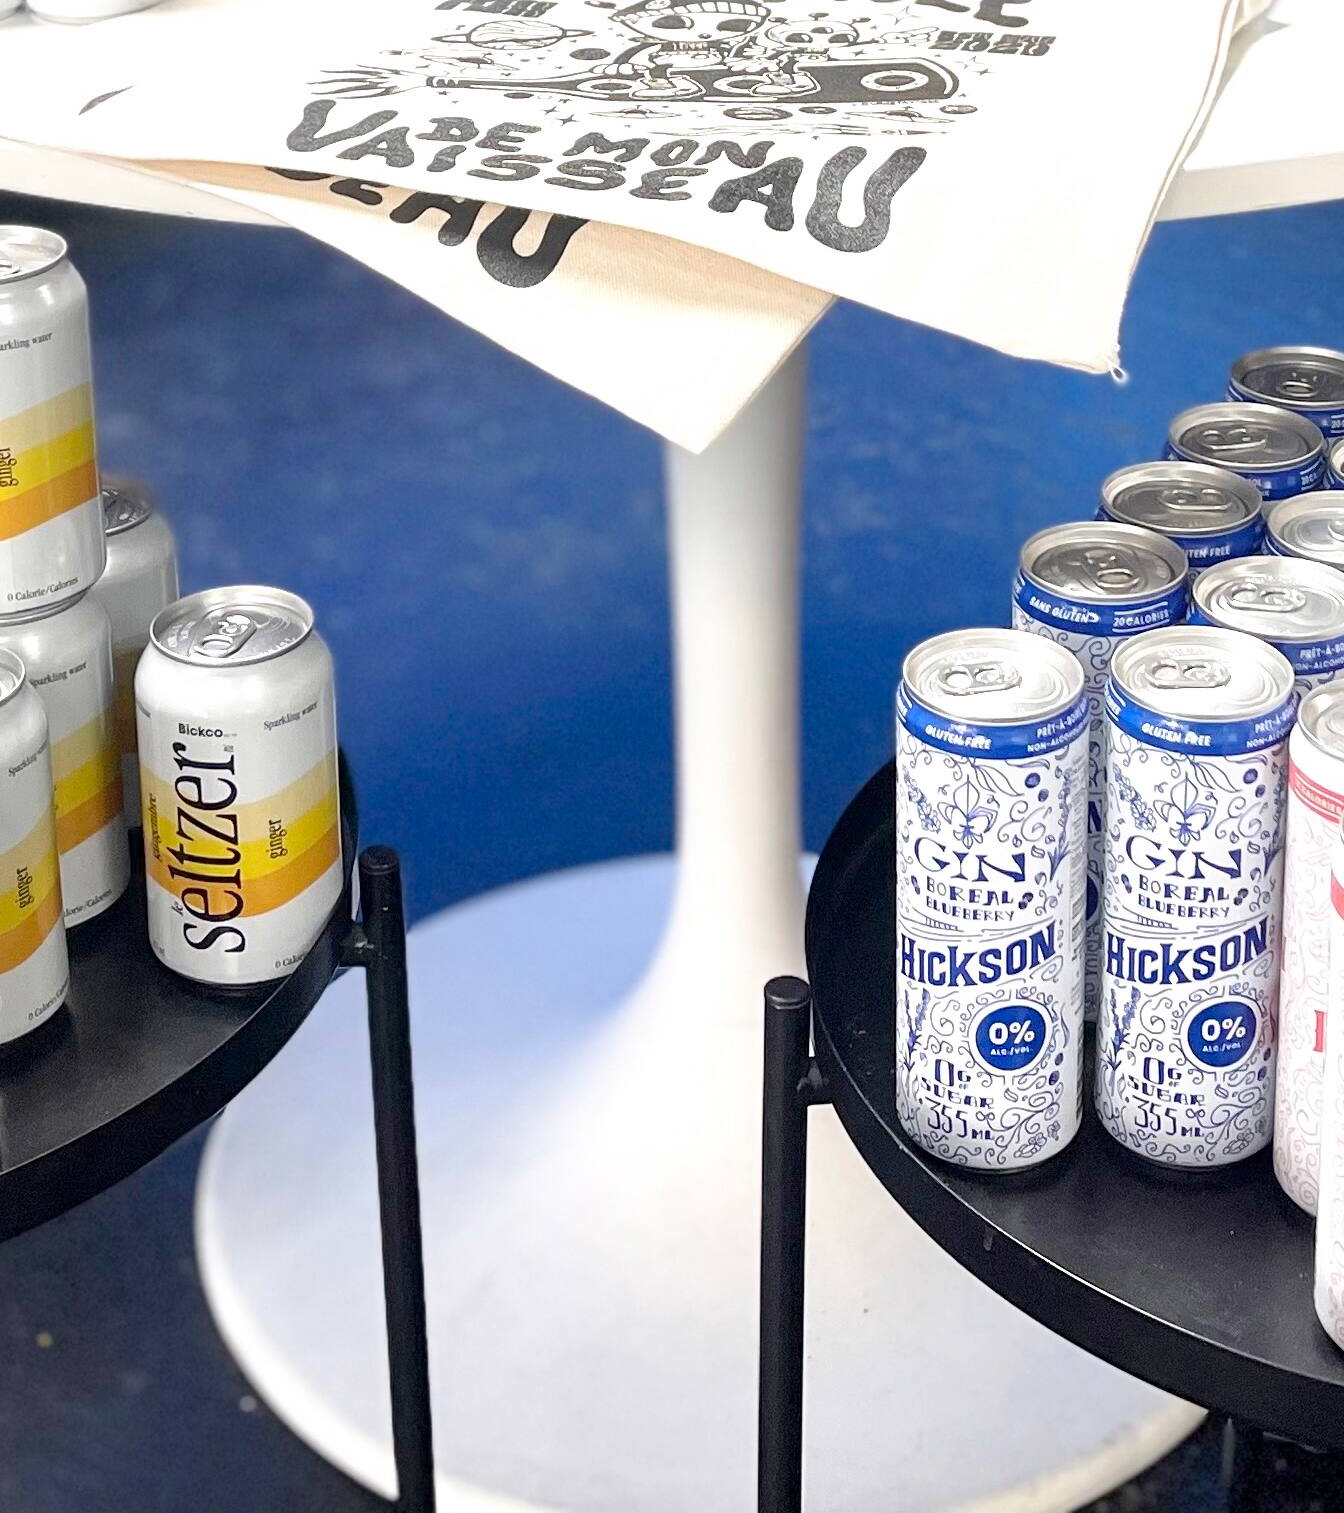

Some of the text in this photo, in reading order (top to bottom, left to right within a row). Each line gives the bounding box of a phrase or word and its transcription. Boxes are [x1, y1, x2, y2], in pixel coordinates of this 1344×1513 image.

[416, 117, 775, 169] DE MON
[286, 99, 928, 253] VAISSEAU
[263, 709, 300, 731] Sparkling
[1142, 723, 1211, 746] GLUTEN FREE
[166, 741, 246, 953] seltzer
[266, 819, 287, 859] ginger
[1126, 835, 1241, 879] GIN
[915, 837, 1025, 882] GIN
[15, 866, 33, 909] ginger
[927, 876, 1013, 905] BOREAL
[1139, 874, 1229, 903] BOREAL
[1139, 894, 1229, 918] BLUEBERRY
[926, 896, 1015, 921] BLUEBERRY
[901, 922, 1055, 986] HICKSON
[1106, 916, 1267, 984] HICKSON
[989, 1020, 1035, 1045] 0%
[1202, 1016, 1246, 1041] 0%
